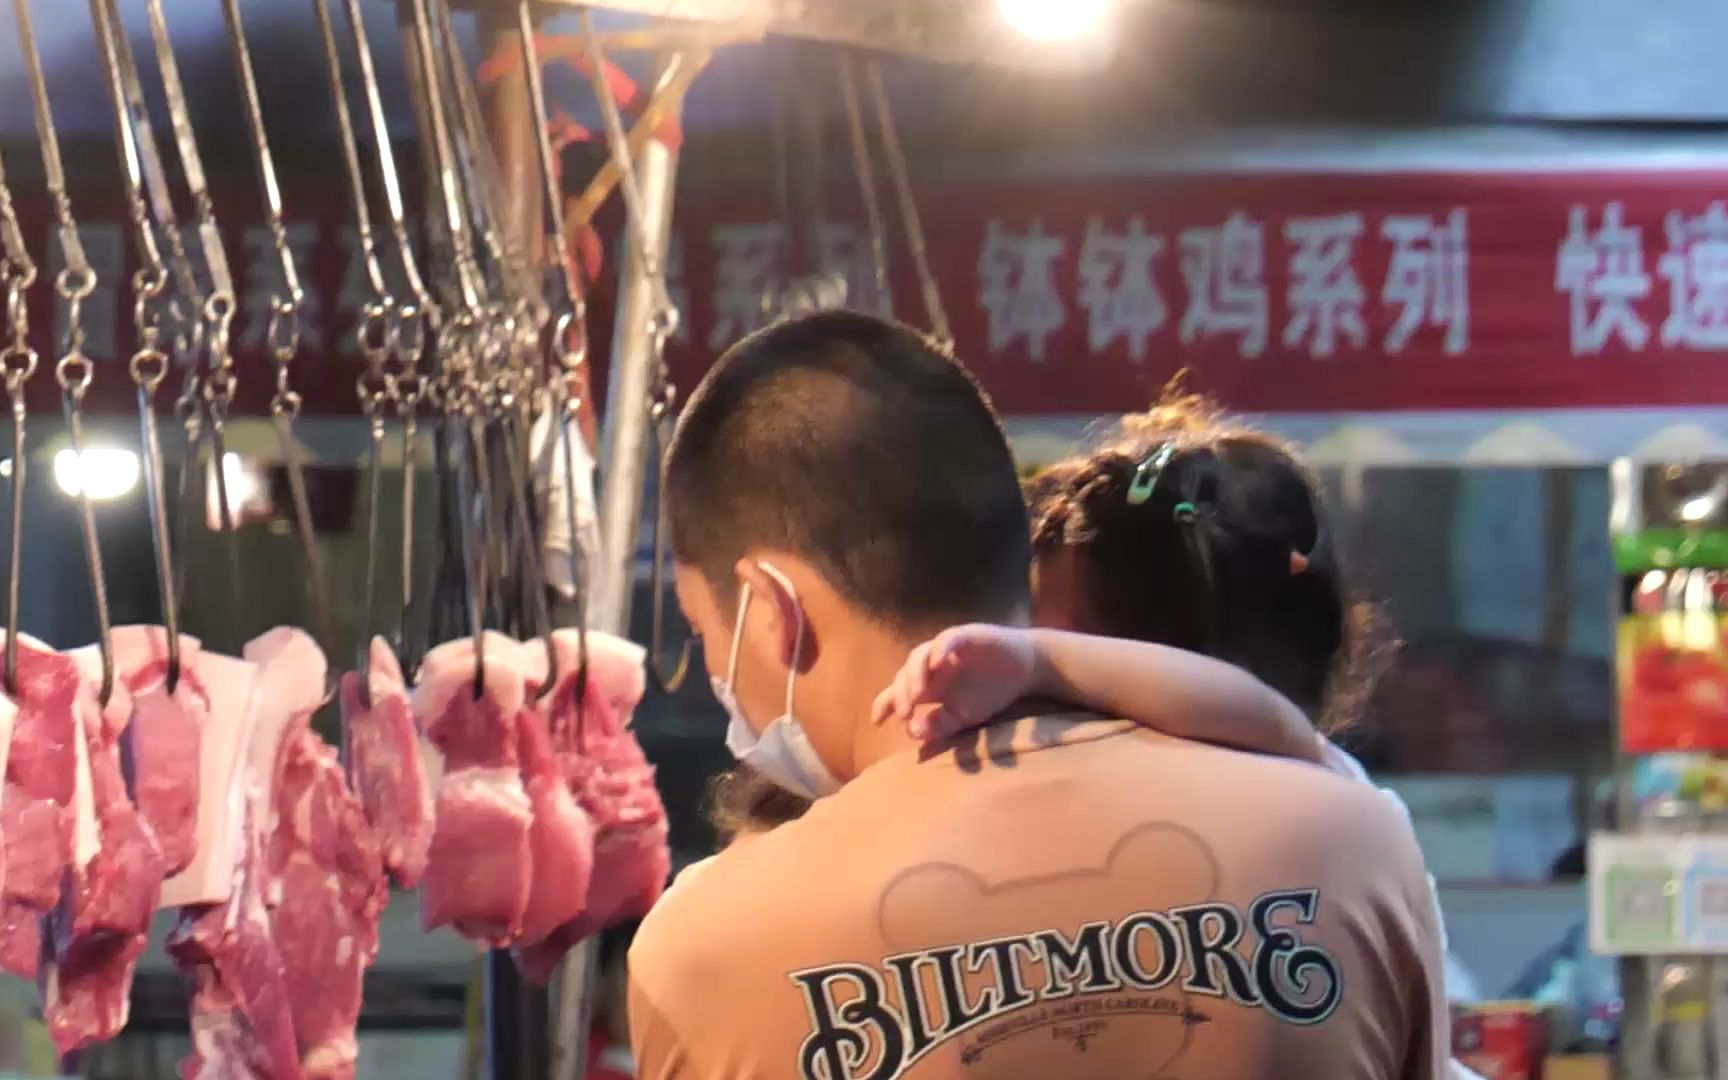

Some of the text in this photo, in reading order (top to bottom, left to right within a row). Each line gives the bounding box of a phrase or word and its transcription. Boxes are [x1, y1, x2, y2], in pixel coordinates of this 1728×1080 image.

[977, 208, 1468, 361] 钵钵鸡系列
